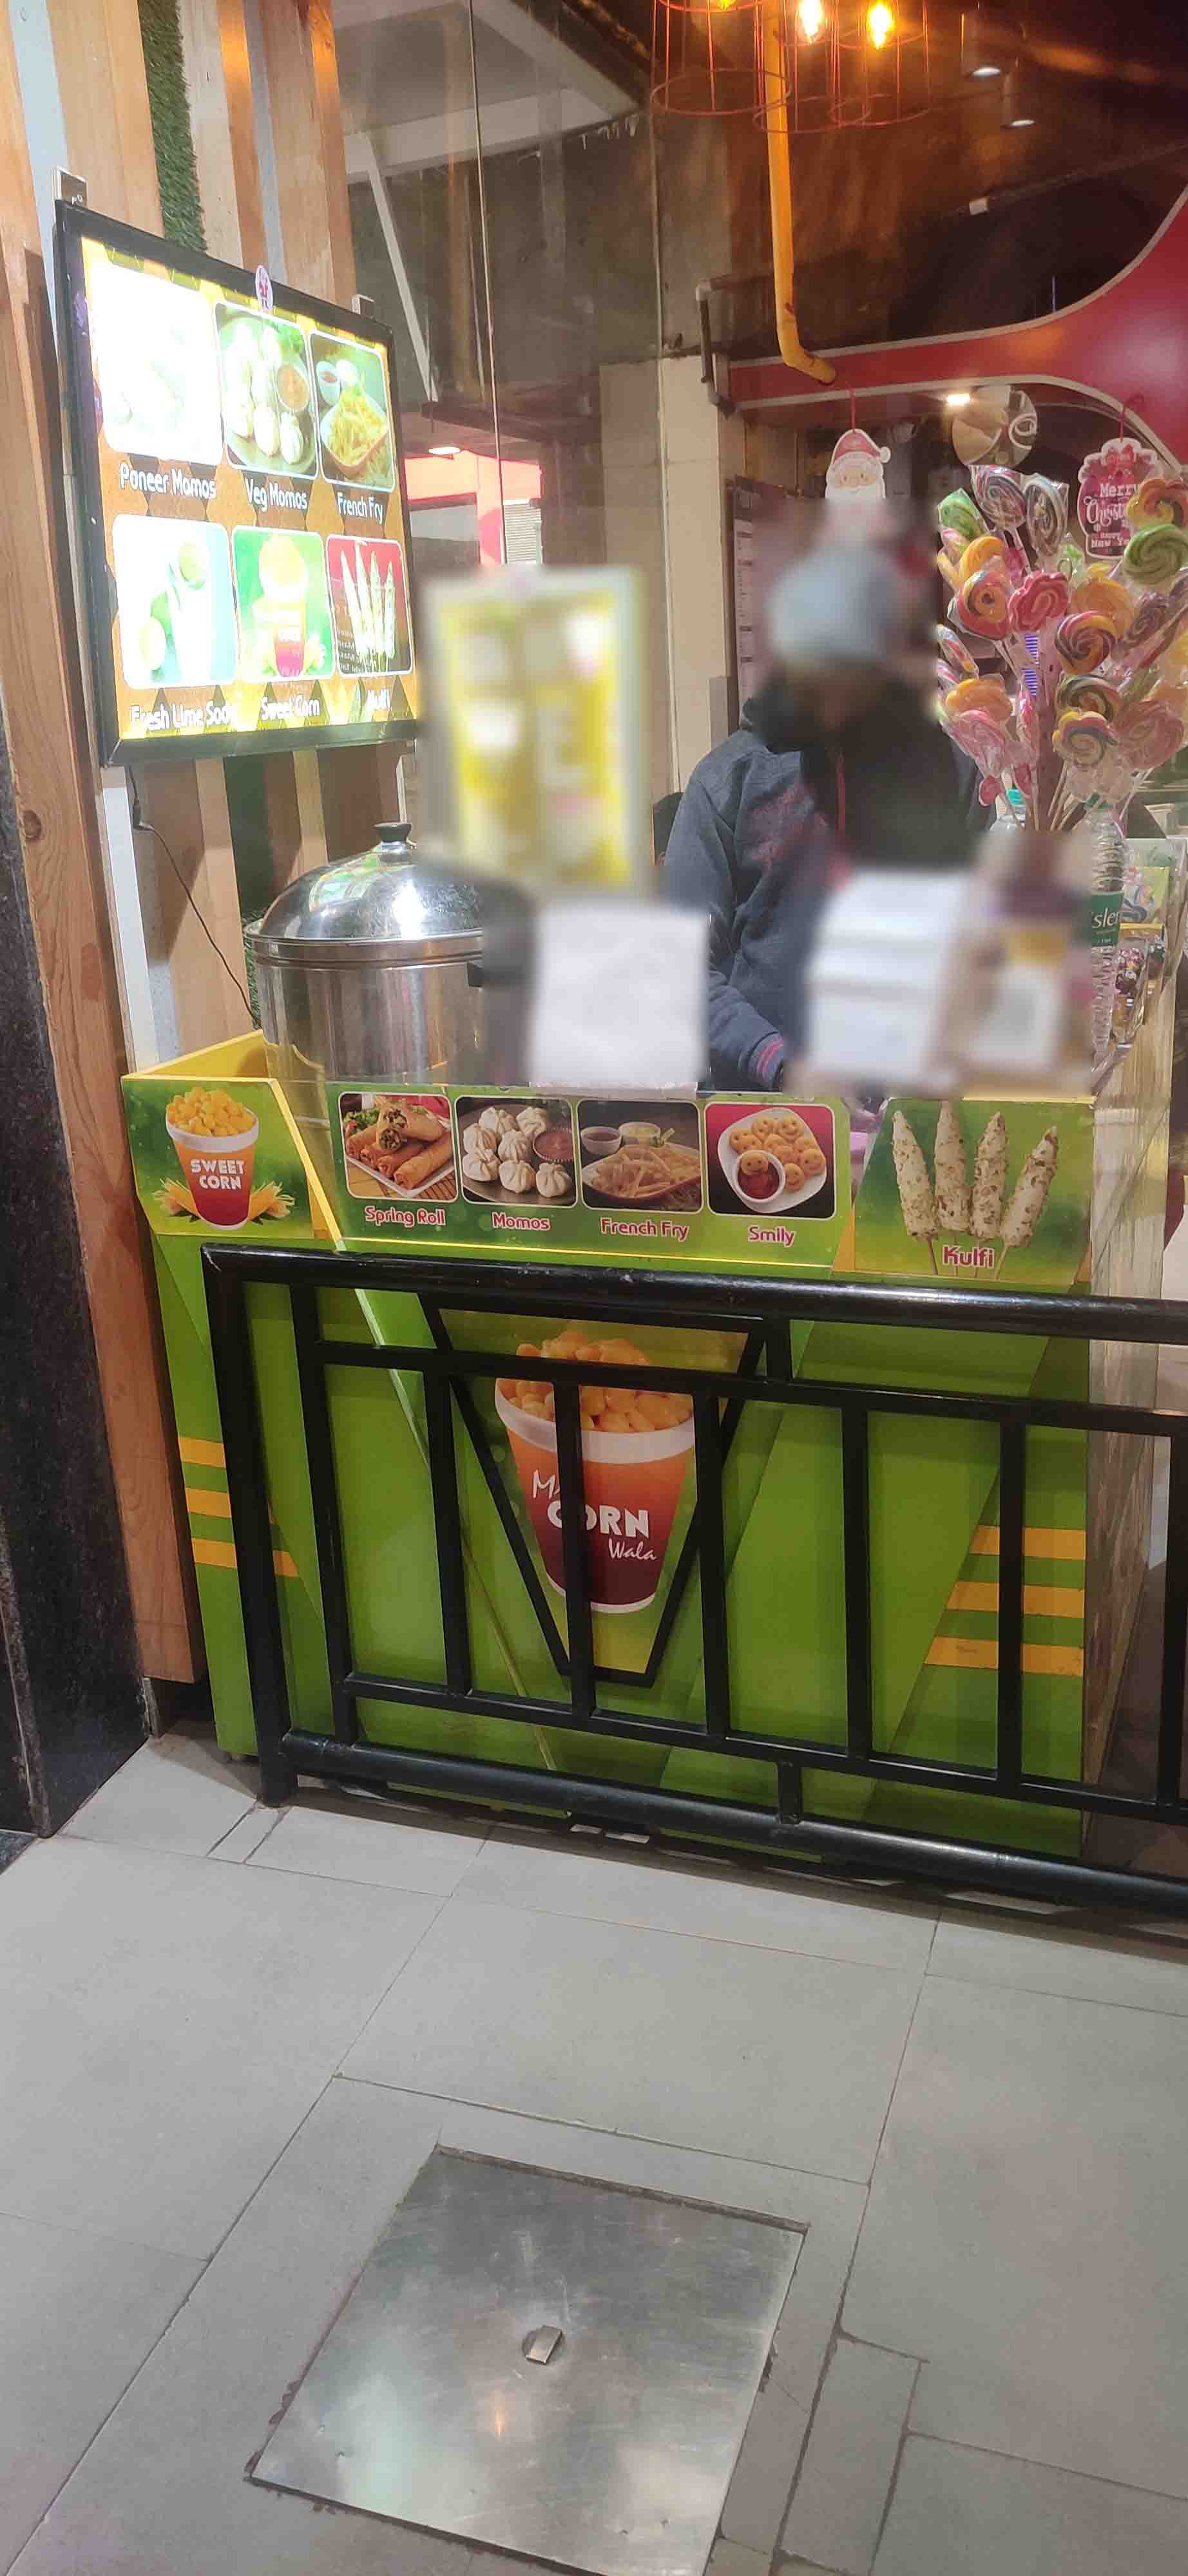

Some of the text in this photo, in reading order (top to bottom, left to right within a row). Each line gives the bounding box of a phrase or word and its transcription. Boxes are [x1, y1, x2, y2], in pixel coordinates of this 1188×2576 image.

[119, 462, 217, 500] Paneer Momos
[245, 478, 308, 512] Veg Momos
[337, 492, 384, 526] French Fry
[191, 1159, 245, 1175] SWEET
[199, 1174, 242, 1189] CORN
[365, 1206, 446, 1227] Spring Roll
[492, 1211, 551, 1231] Momos
[600, 1217, 689, 1242] French Fry
[747, 1224, 795, 1247] Smily
[943, 1244, 995, 1268] Kulfi
[608, 1538, 657, 1560] Wala
